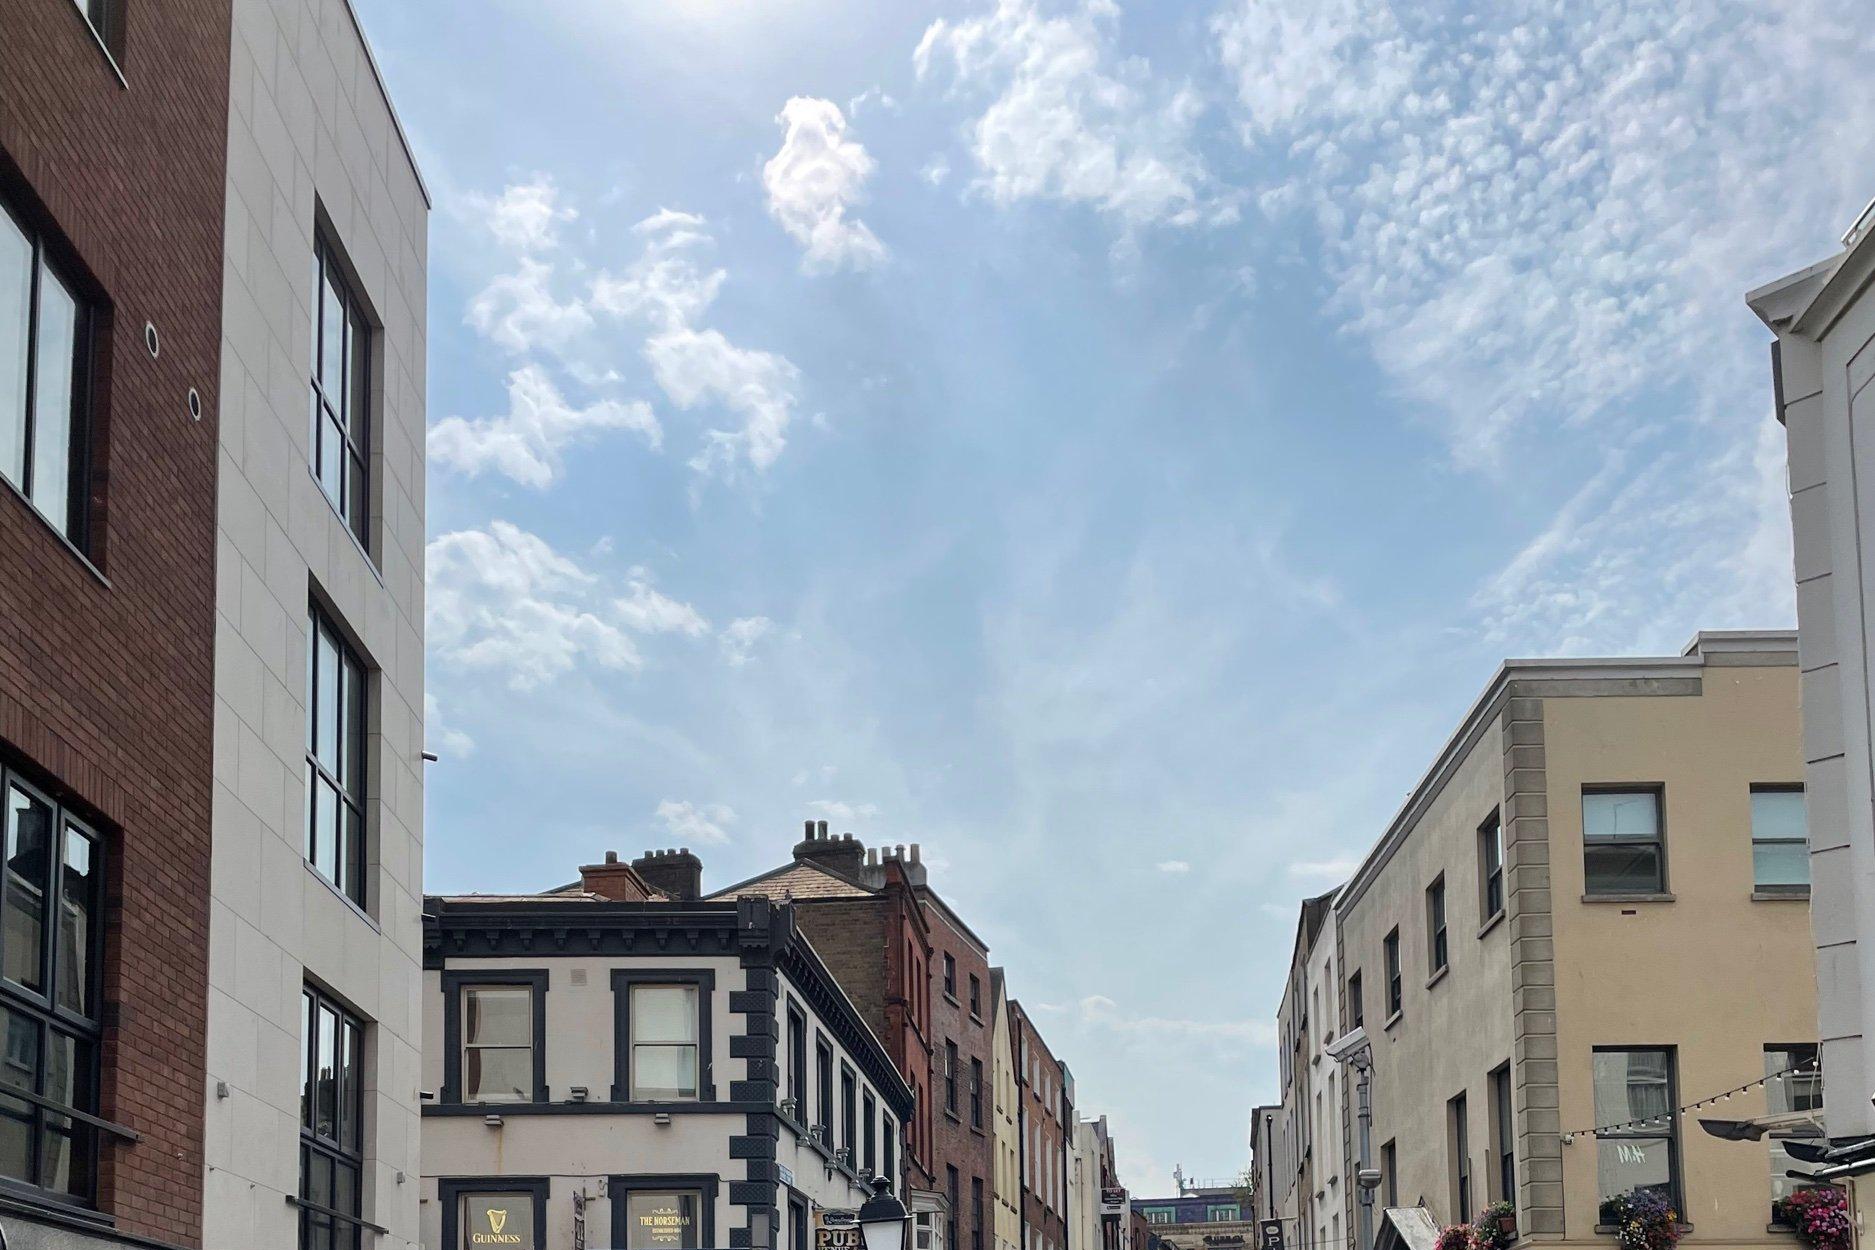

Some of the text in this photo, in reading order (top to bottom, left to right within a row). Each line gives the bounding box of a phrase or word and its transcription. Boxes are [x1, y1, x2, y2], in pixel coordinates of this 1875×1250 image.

[640, 1216, 690, 1226] THE NORSEMAN
[472, 1233, 521, 1243] GUINNESS
[817, 1230, 860, 1247] PUB
